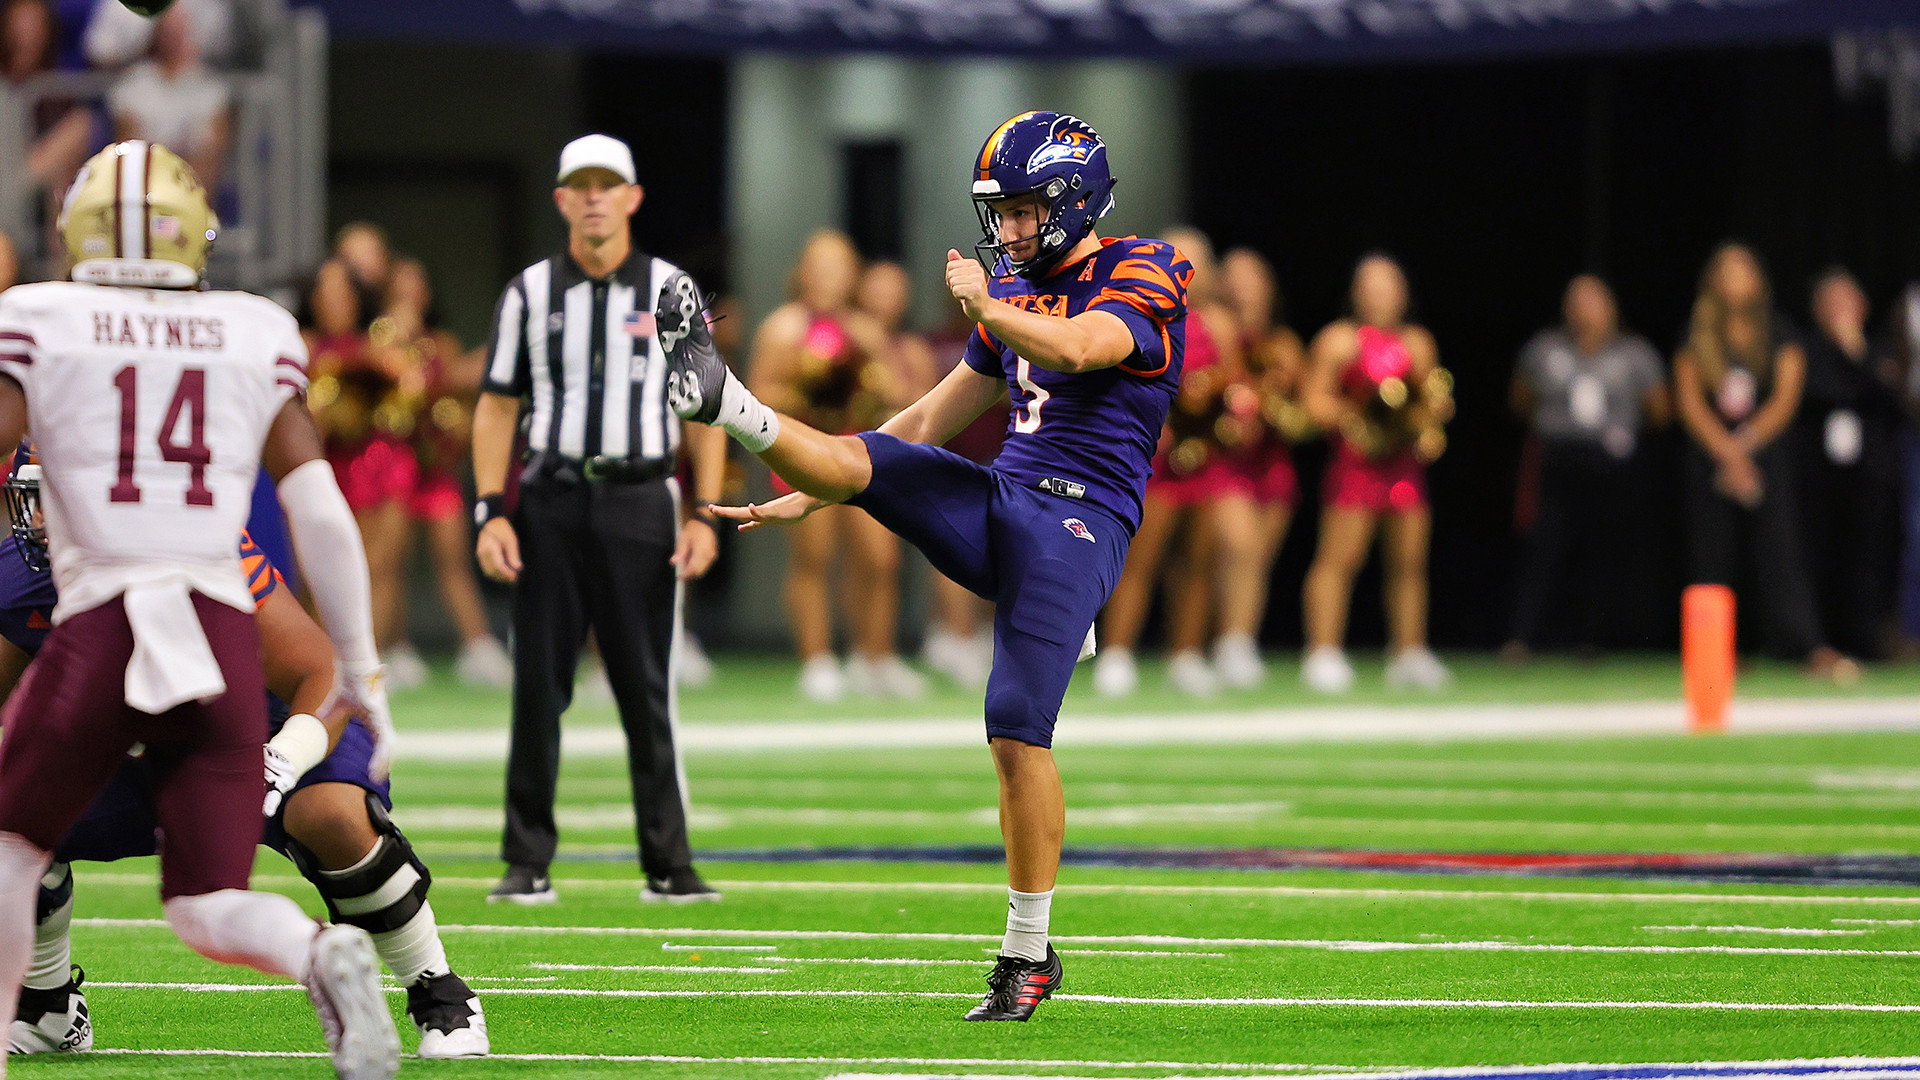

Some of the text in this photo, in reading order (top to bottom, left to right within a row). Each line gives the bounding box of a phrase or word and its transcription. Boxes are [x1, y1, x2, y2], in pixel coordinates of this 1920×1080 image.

[92, 310, 224, 349] HAYNES
[999, 294, 1069, 318] TSA
[1014, 354, 1051, 435] 5
[110, 365, 214, 507] 14
